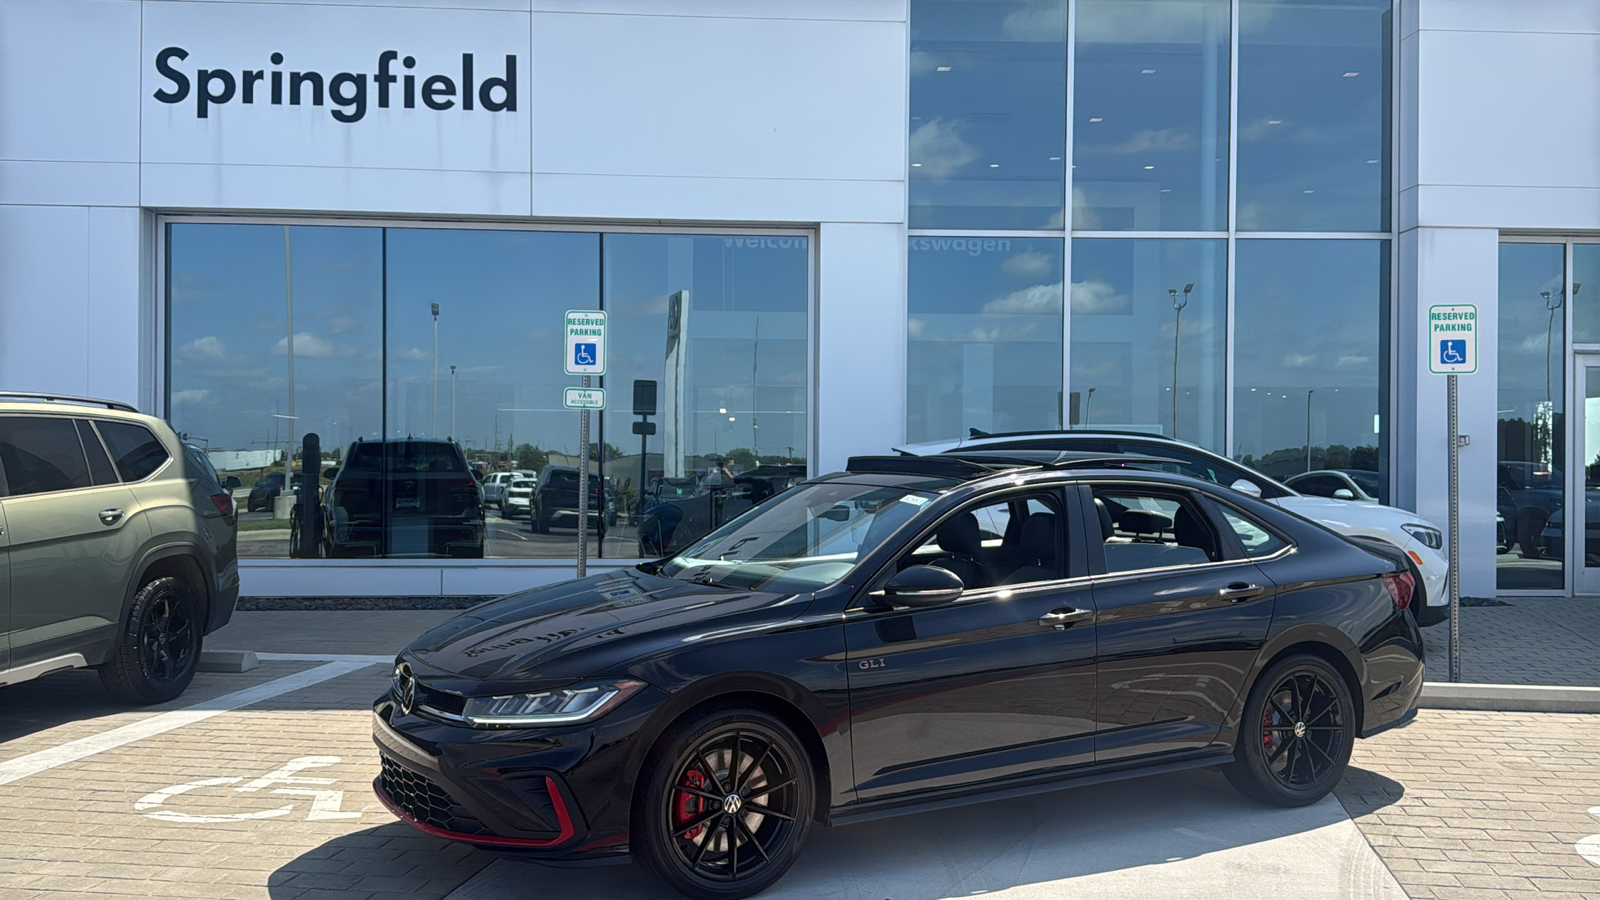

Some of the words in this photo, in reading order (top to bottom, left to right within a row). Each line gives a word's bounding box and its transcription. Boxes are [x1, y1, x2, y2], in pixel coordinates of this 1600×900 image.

[152, 46, 518, 124] Springfield
[1431, 312, 1474, 320] RESERVED
[567, 318, 604, 326] RESERVED
[1434, 323, 1472, 331] PARKING
[570, 328, 602, 336] PARKING
[859, 658, 886, 670] GLI
